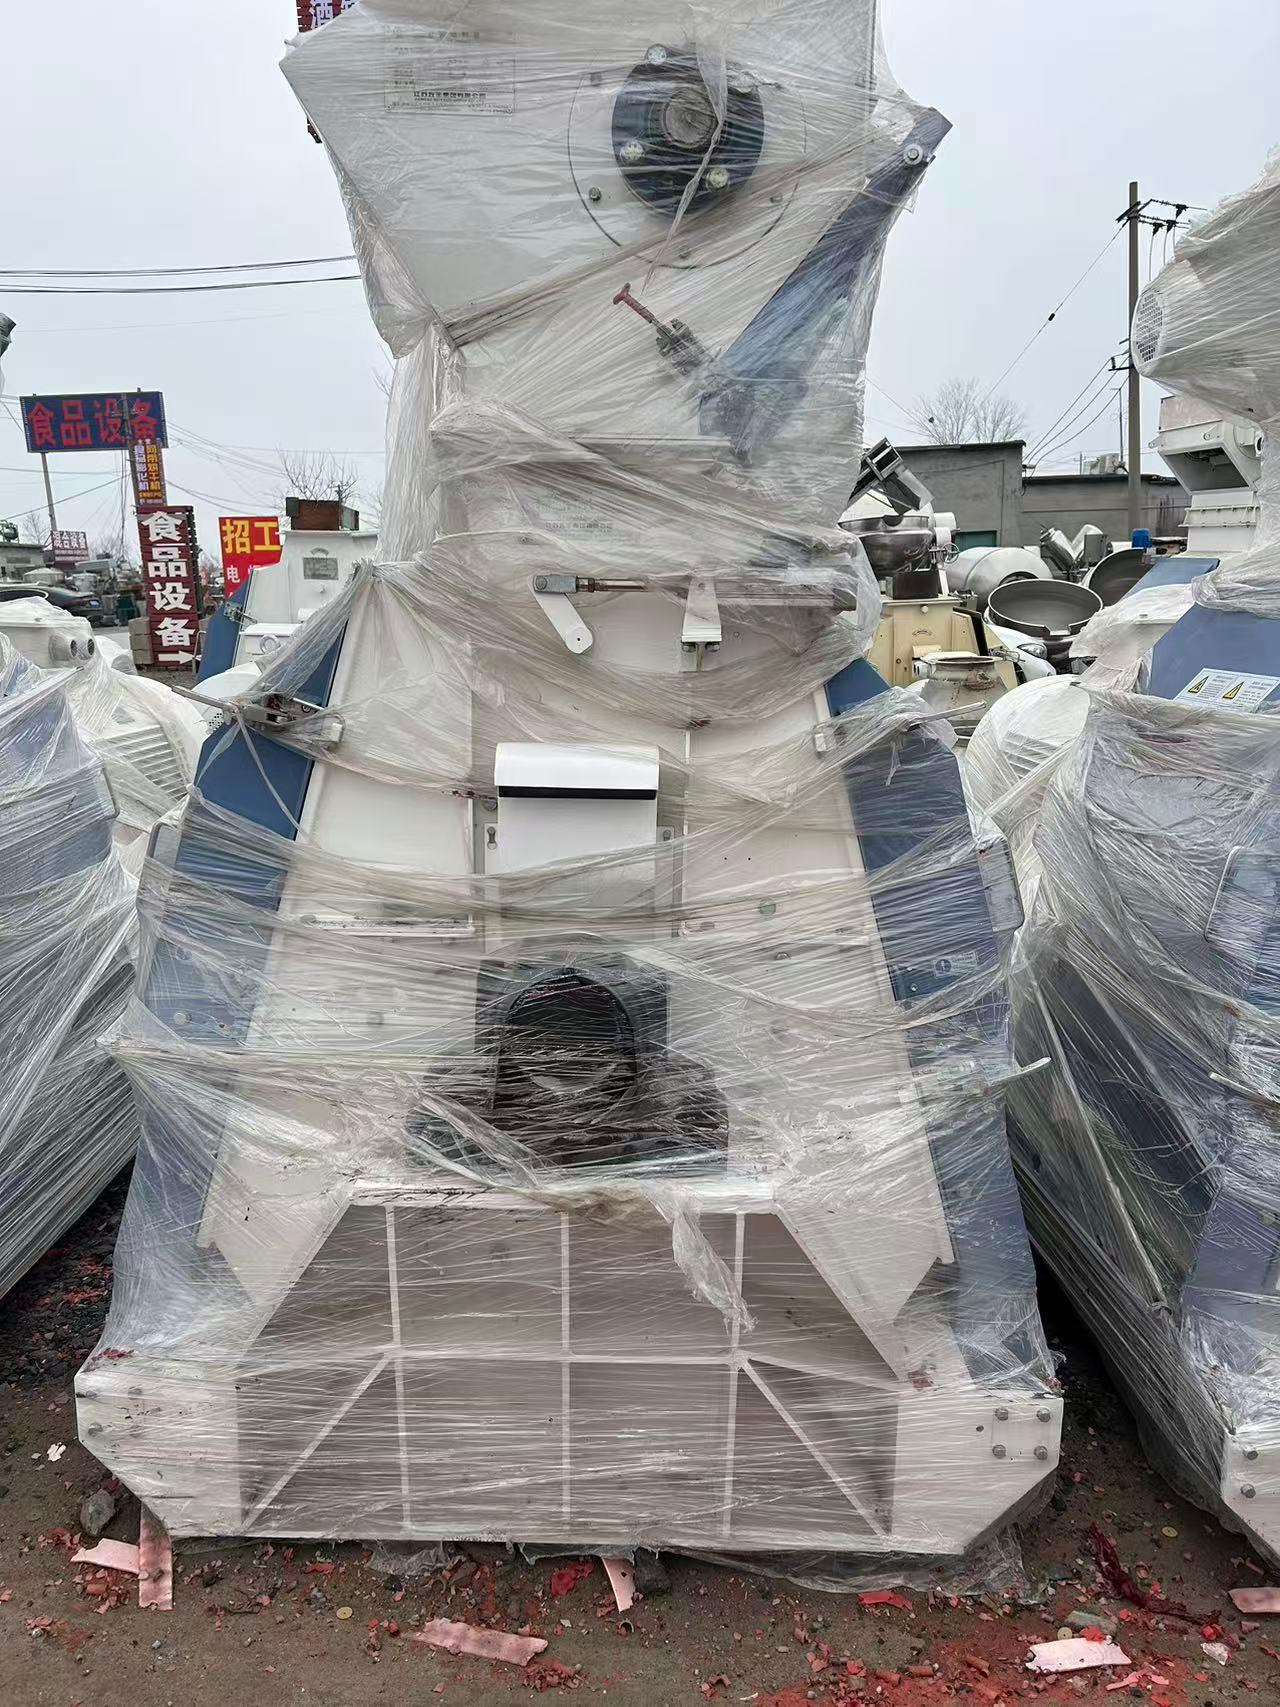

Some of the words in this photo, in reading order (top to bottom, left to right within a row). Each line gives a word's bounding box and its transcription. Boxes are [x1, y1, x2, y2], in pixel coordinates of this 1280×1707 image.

[28, 399, 158, 447] 食品设备
[222, 519, 281, 554] 招工
[141, 511, 196, 647] 食品设备
